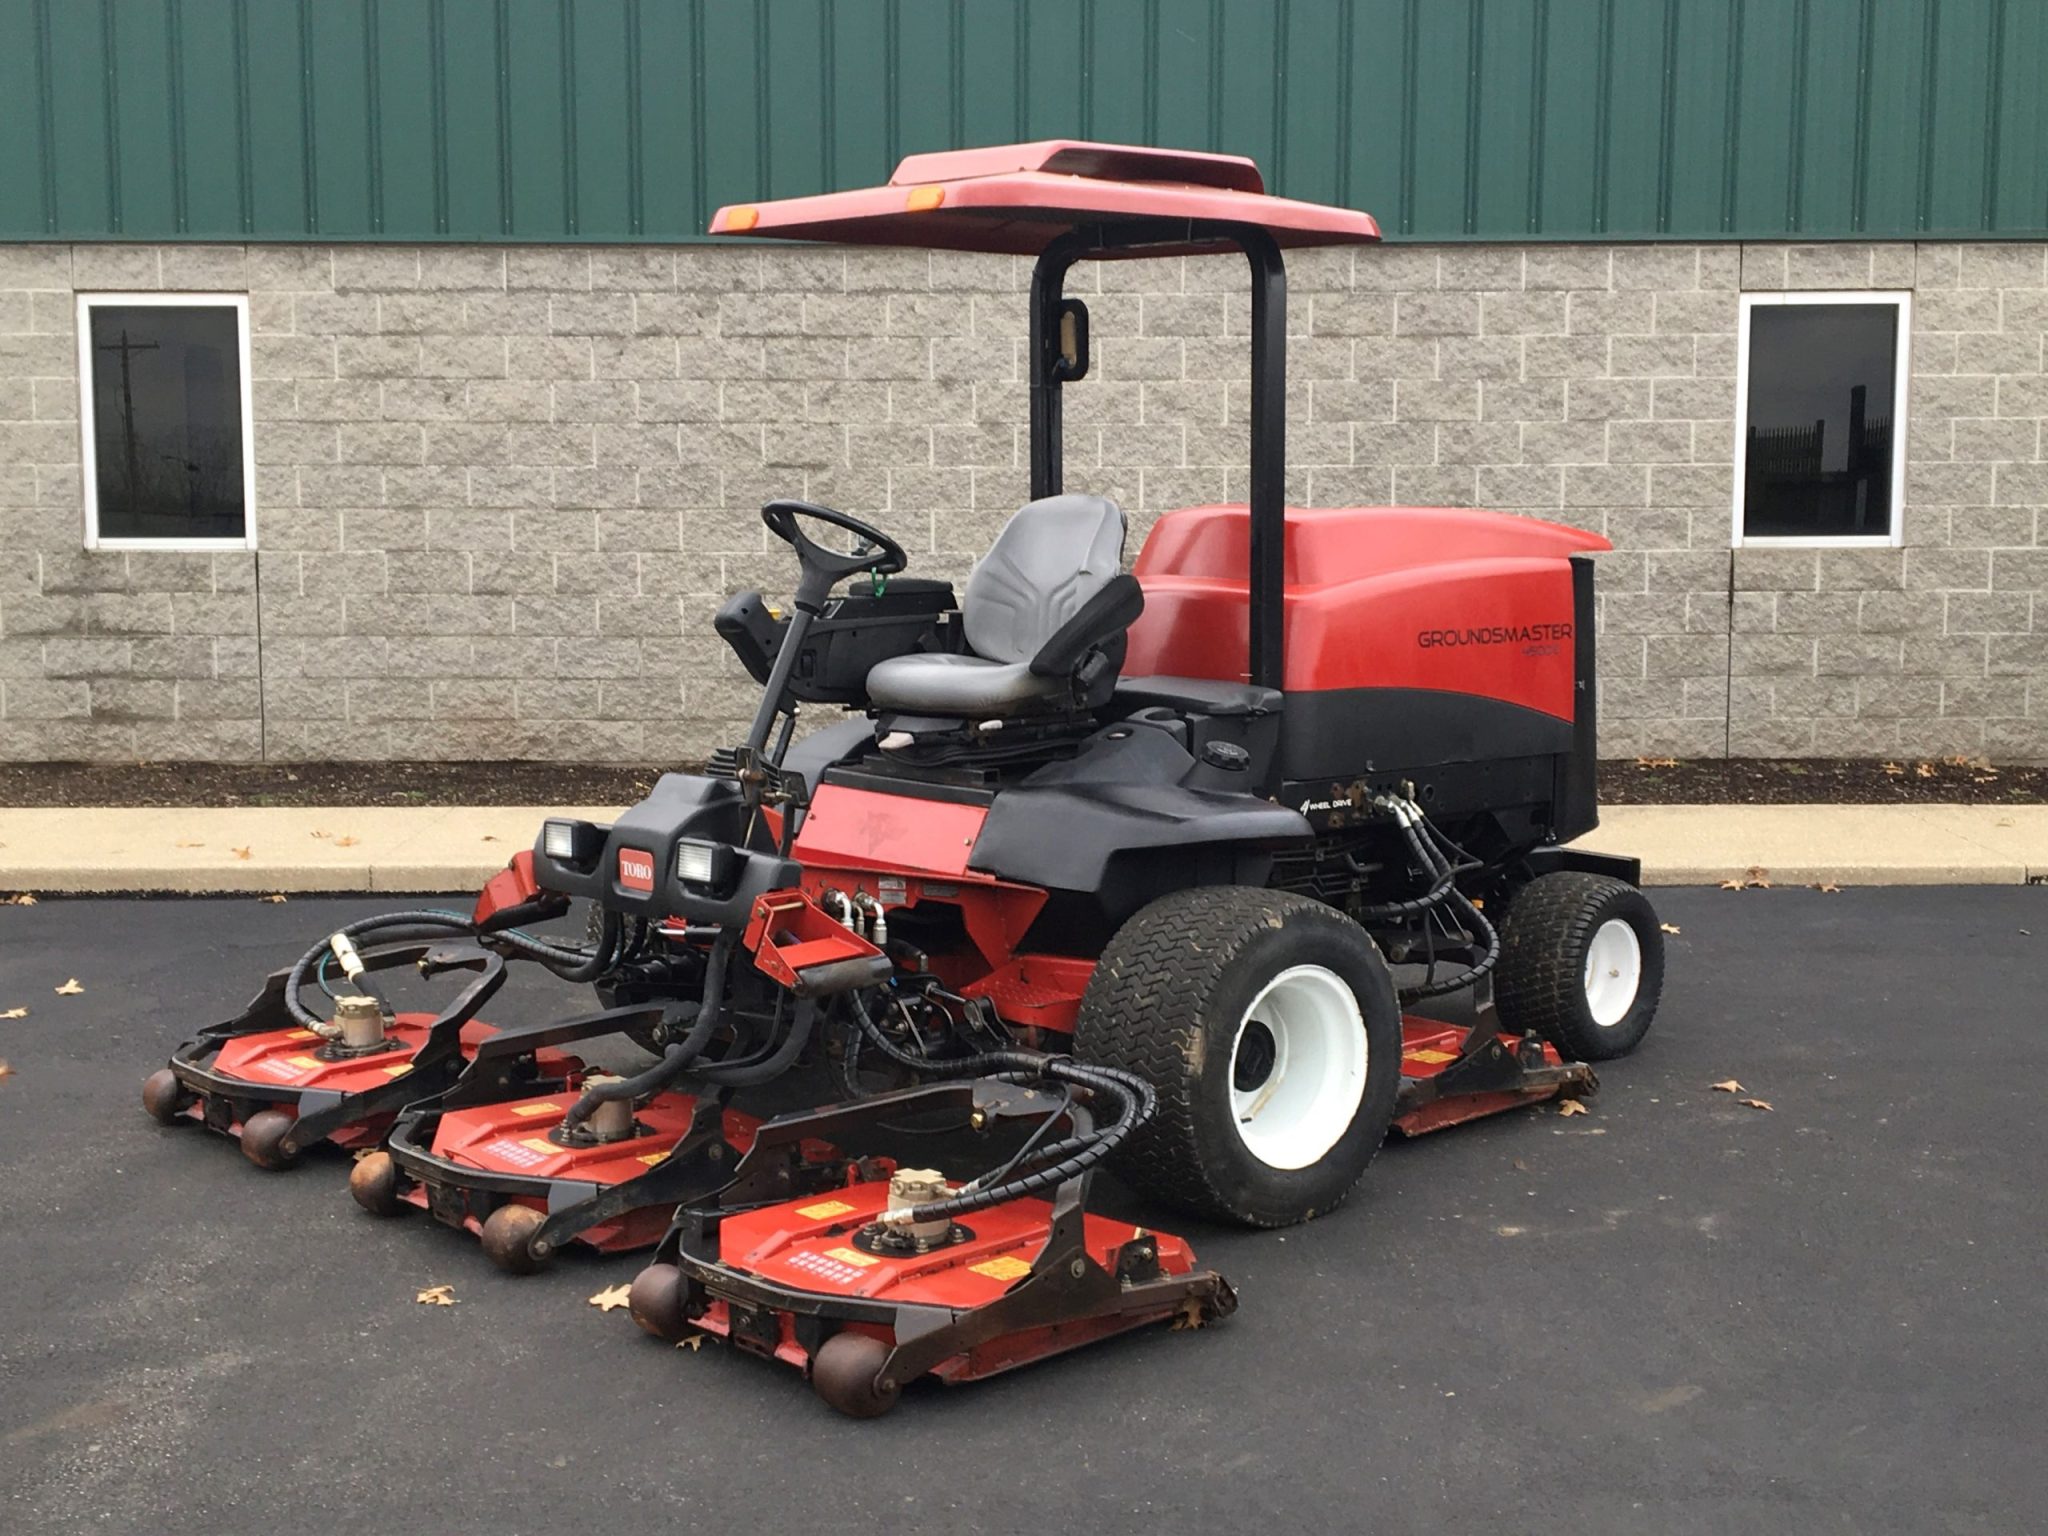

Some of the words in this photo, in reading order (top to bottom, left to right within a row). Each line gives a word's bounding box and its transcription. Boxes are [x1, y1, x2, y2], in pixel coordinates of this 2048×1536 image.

[1418, 623, 1573, 648] GROUNDSMASTER
[1300, 799, 1310, 816] 4
[1310, 802, 1331, 810] WHEEL
[1332, 799, 1352, 808] DRIVE
[621, 860, 652, 880] TORO
